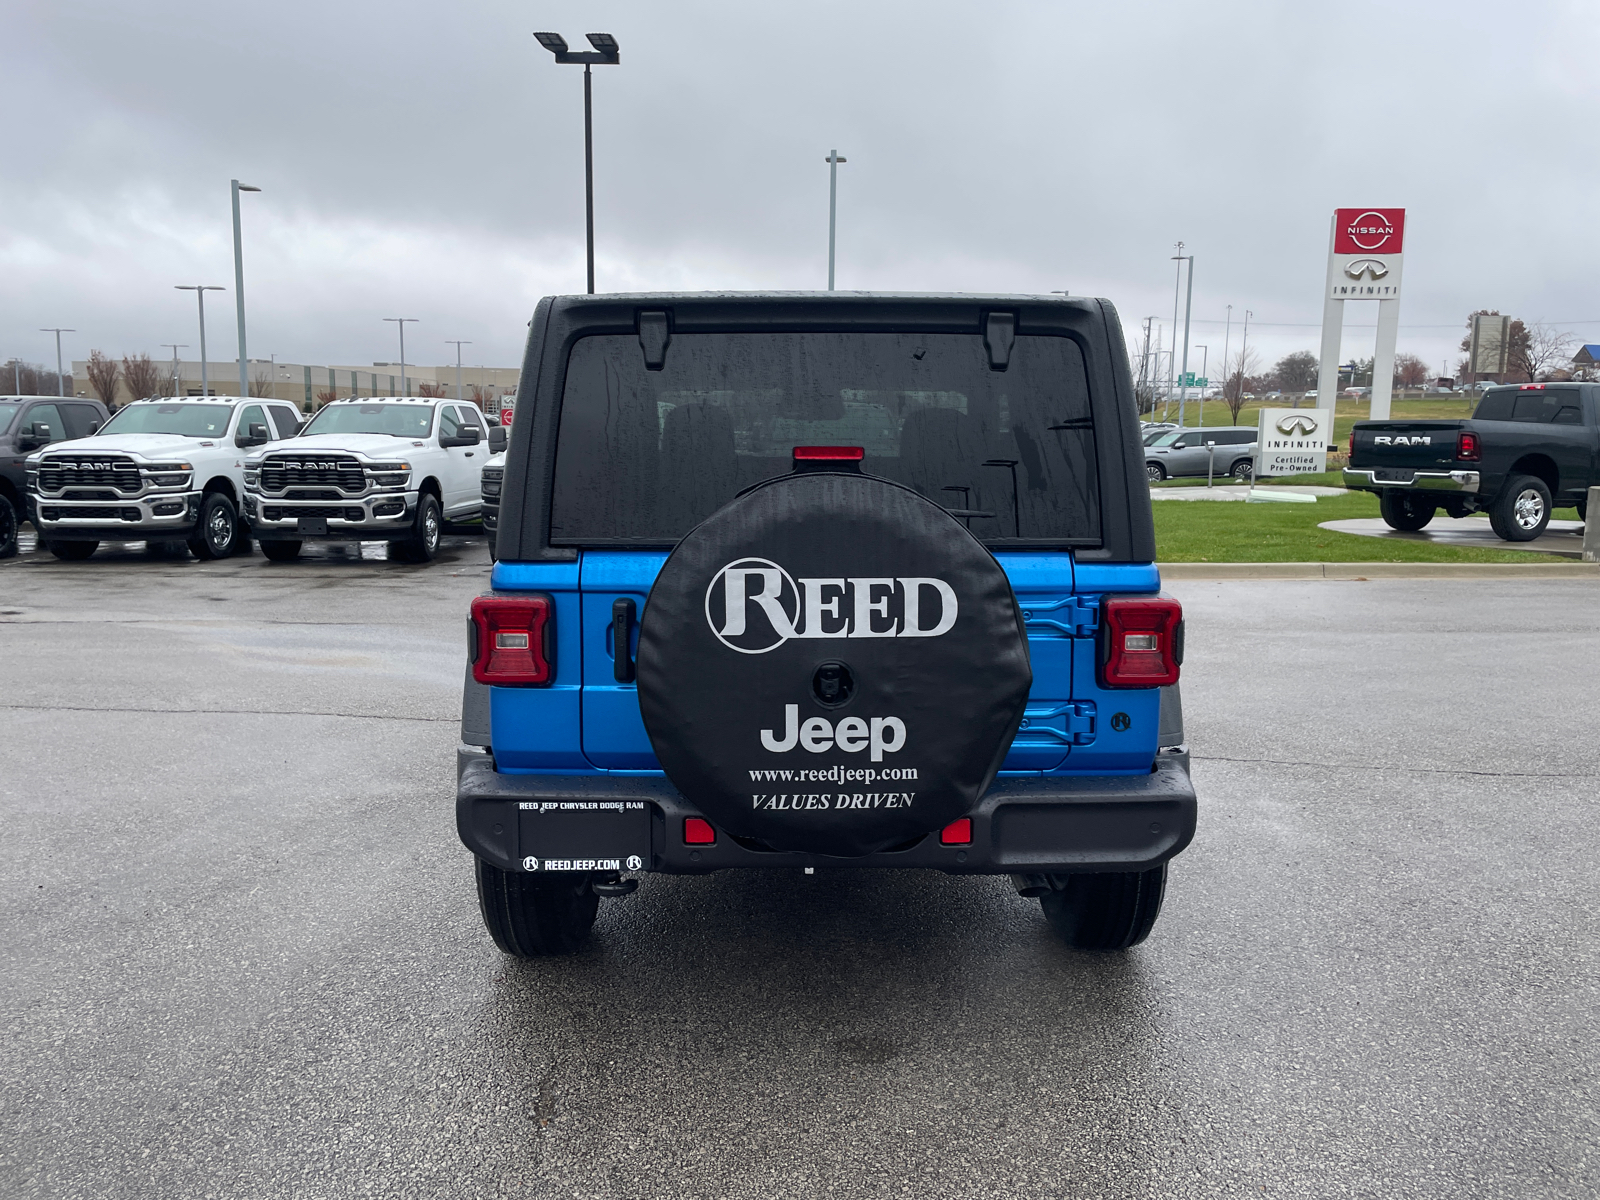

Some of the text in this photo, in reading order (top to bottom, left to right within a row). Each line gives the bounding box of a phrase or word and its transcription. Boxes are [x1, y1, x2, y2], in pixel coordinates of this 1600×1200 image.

[1333, 286, 1397, 294] INFINITI
[1267, 440, 1323, 448] INFINITI
[1374, 436, 1431, 445] RAM
[718, 567, 959, 639] REED
[760, 703, 907, 762] Jeep
[749, 765, 918, 785] www.reedjeep.com
[519, 802, 538, 810] REED
[541, 802, 558, 810] JEEP
[560, 802, 598, 810] CHRYSLER
[752, 793, 915, 810] VALUES DRIVEN
[545, 860, 620, 871] REEDJEEP.COM
